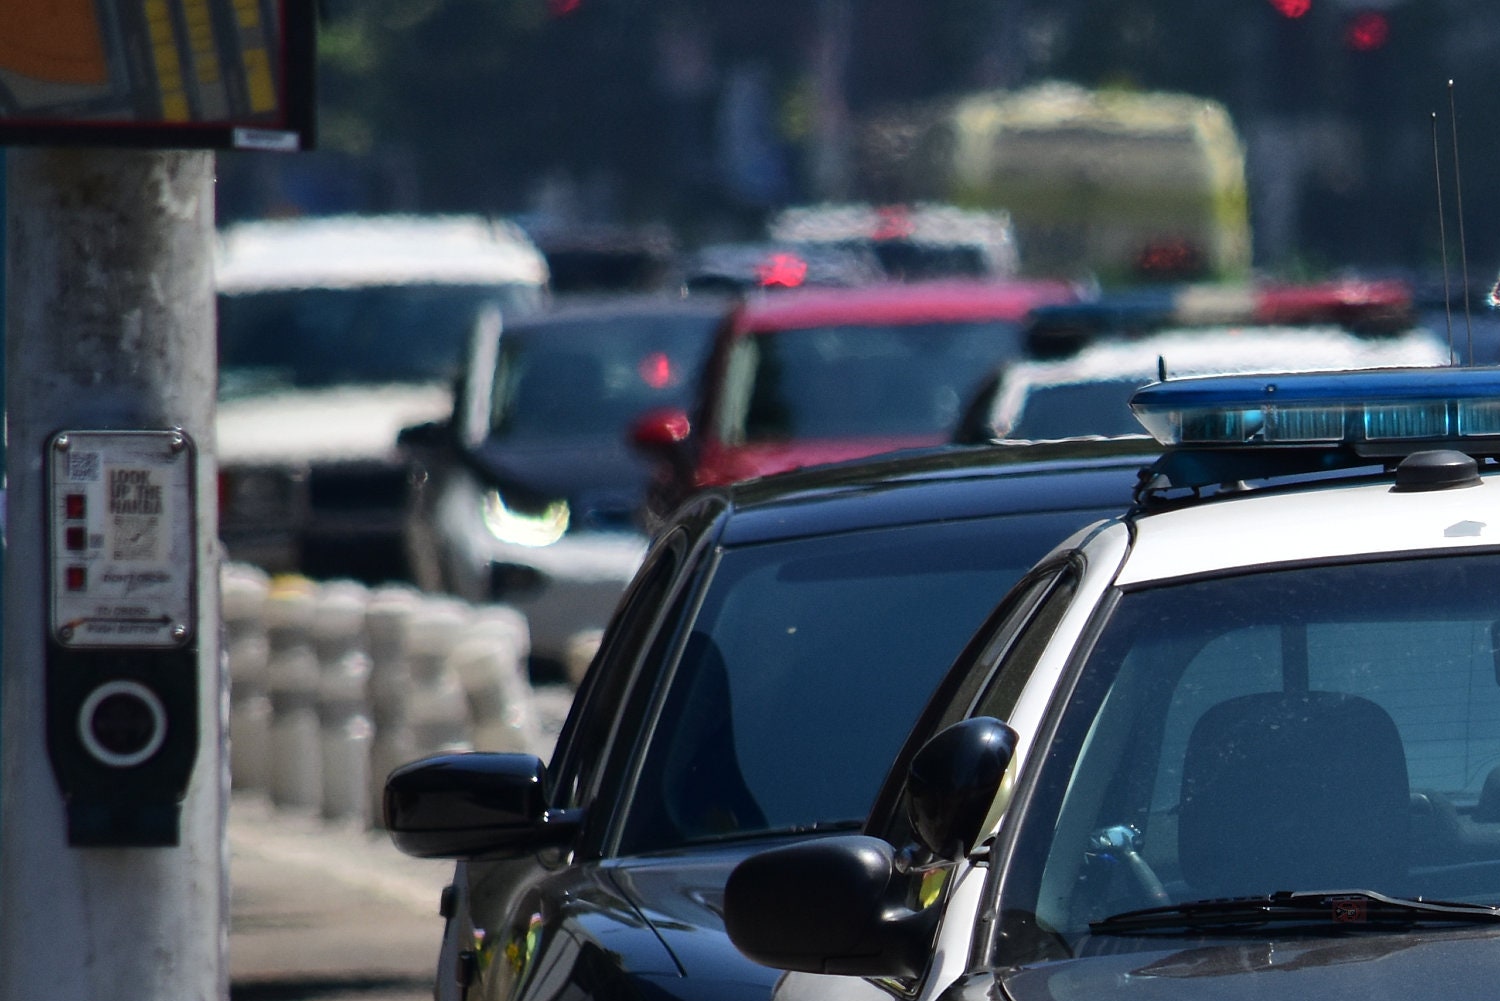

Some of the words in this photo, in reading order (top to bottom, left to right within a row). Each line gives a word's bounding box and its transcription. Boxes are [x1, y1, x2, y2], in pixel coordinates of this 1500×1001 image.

[110, 469, 151, 484] LOOK
[111, 484, 131, 499] UP
[136, 484, 162, 499] THE
